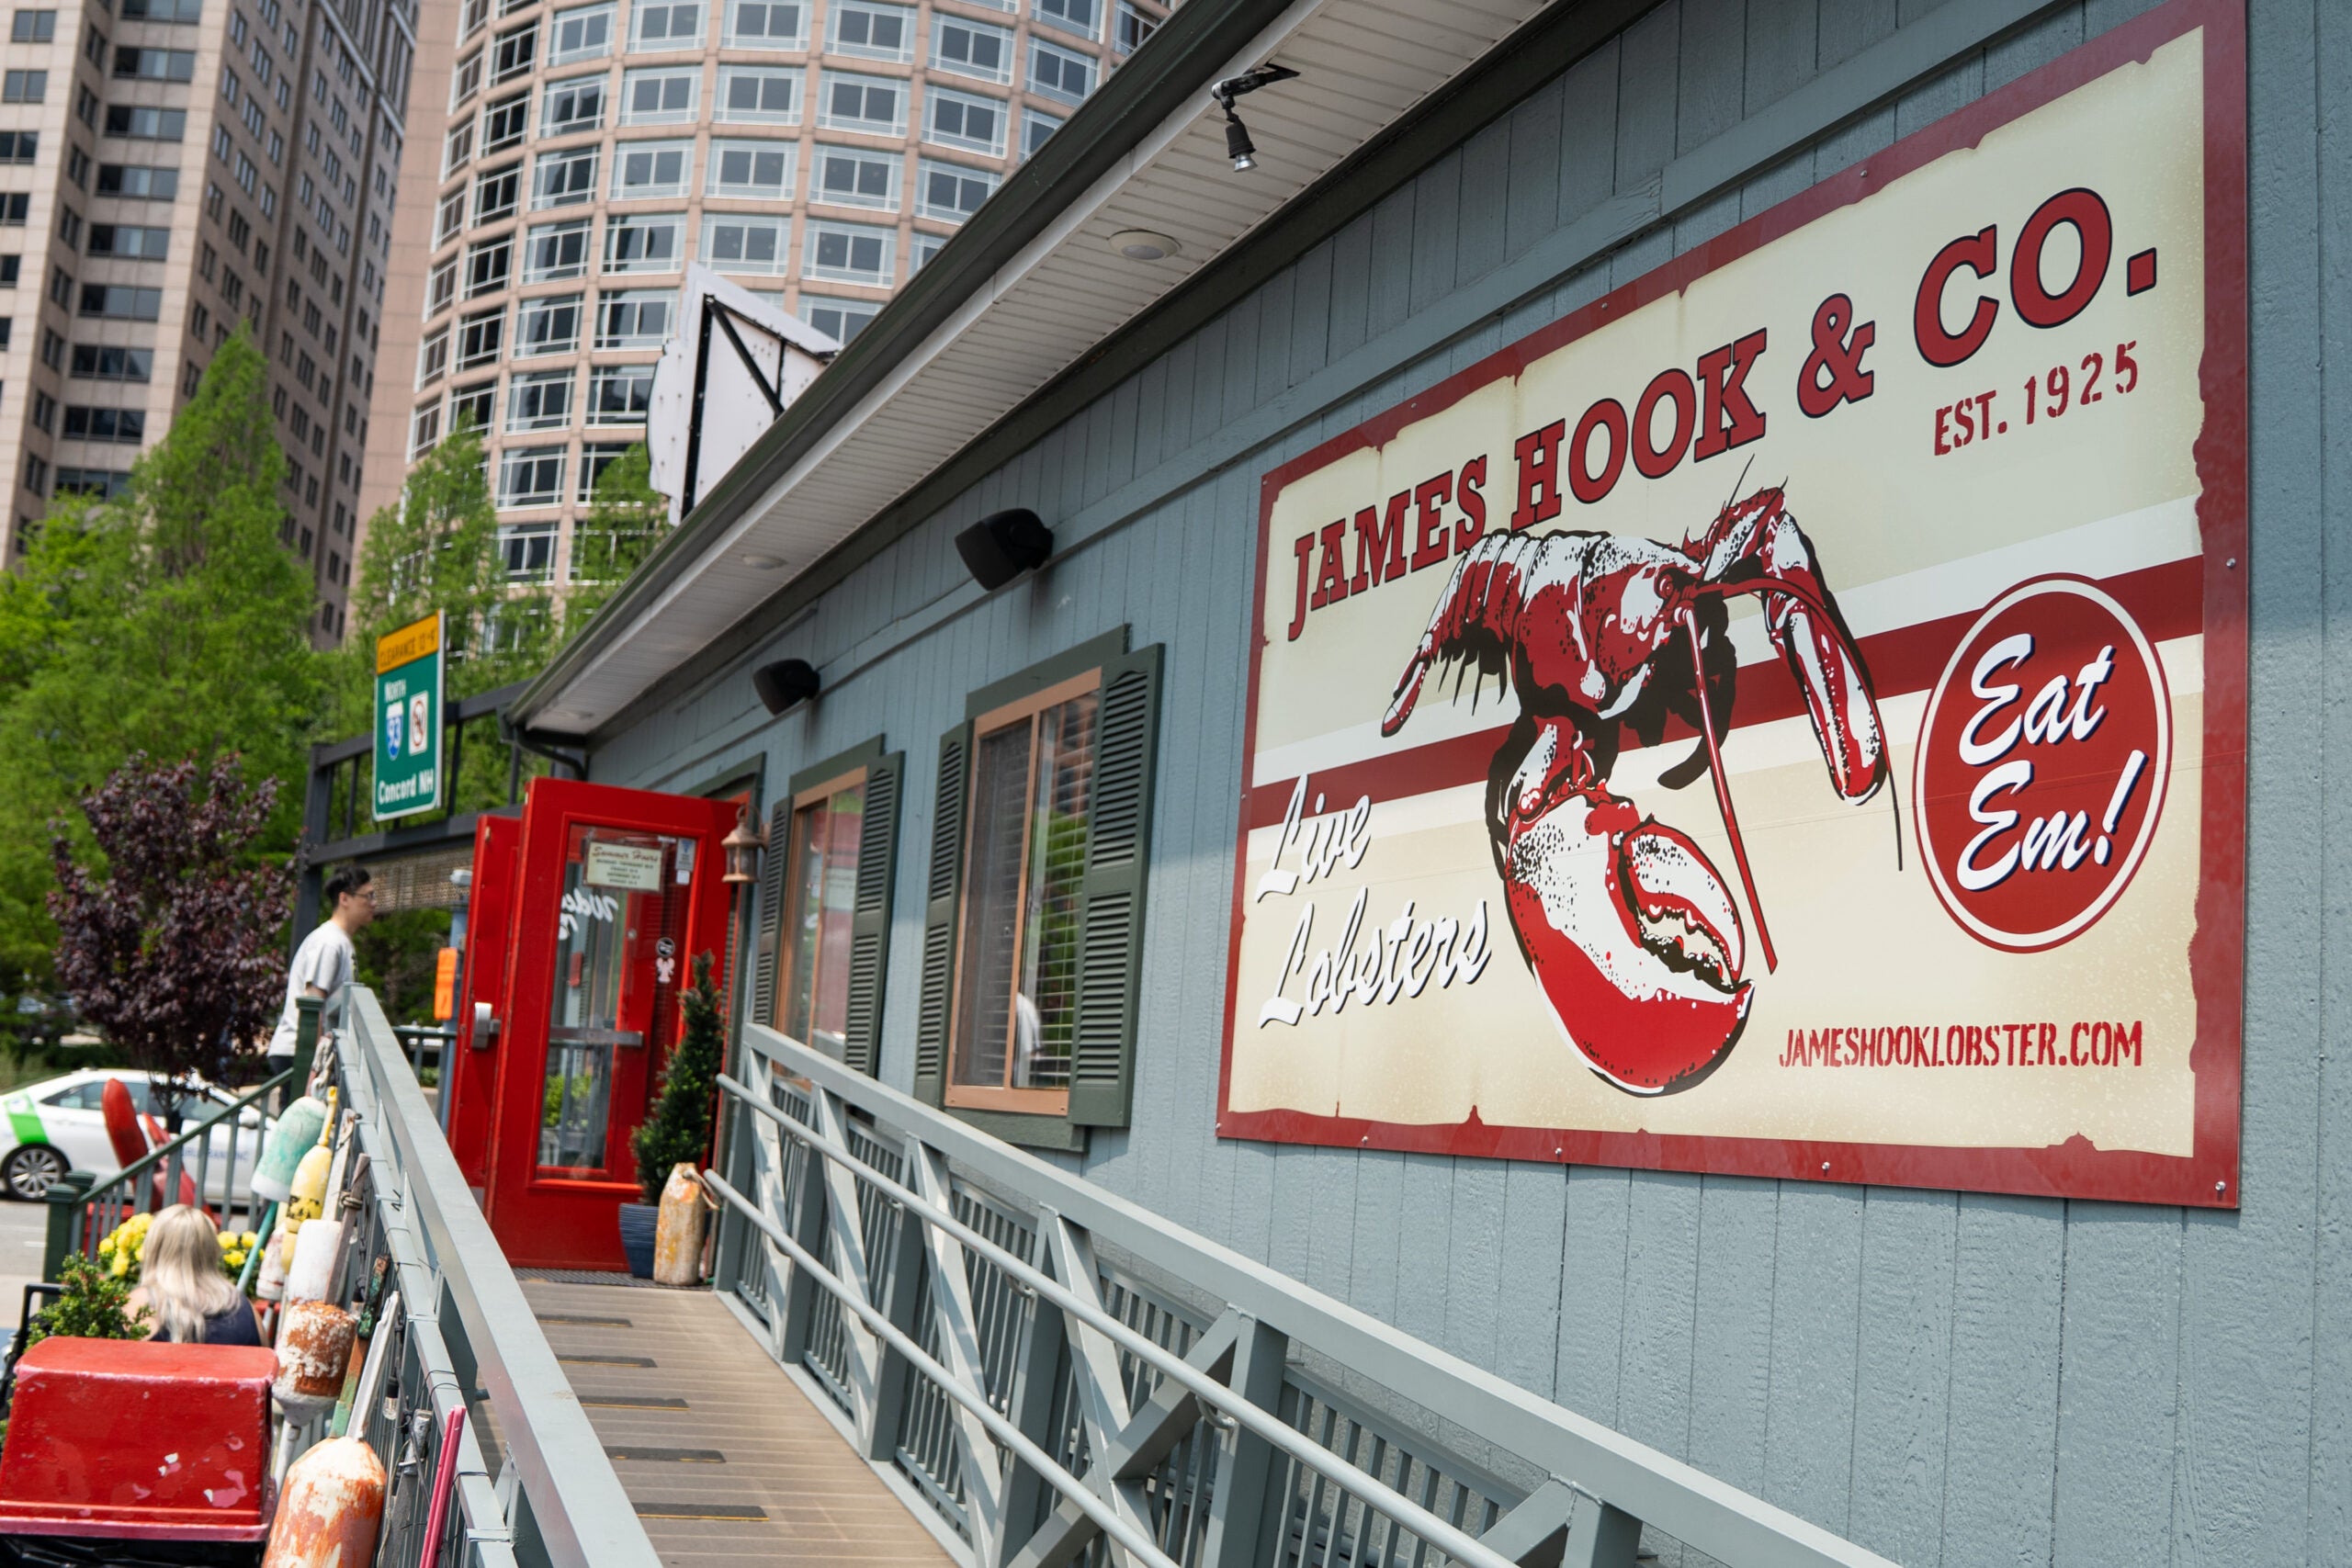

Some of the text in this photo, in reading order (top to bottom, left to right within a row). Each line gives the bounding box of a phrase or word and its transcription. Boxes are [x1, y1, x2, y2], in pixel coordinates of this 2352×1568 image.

[1286, 186, 2157, 641] JAMES HOOK & CO.
[1934, 340, 2139, 456] EST. 1925
[385, 680, 406, 702] NORTH
[388, 716, 401, 748] 93
[1958, 633, 2116, 766] Eat
[379, 770, 434, 804] Concord NH
[1253, 773, 1373, 904] Live
[1956, 750, 2149, 892] Em!
[1258, 885, 1493, 1031] Lobsters
[1778, 1020, 2143, 1068] JAMESHOOKLOBSTER.COM
